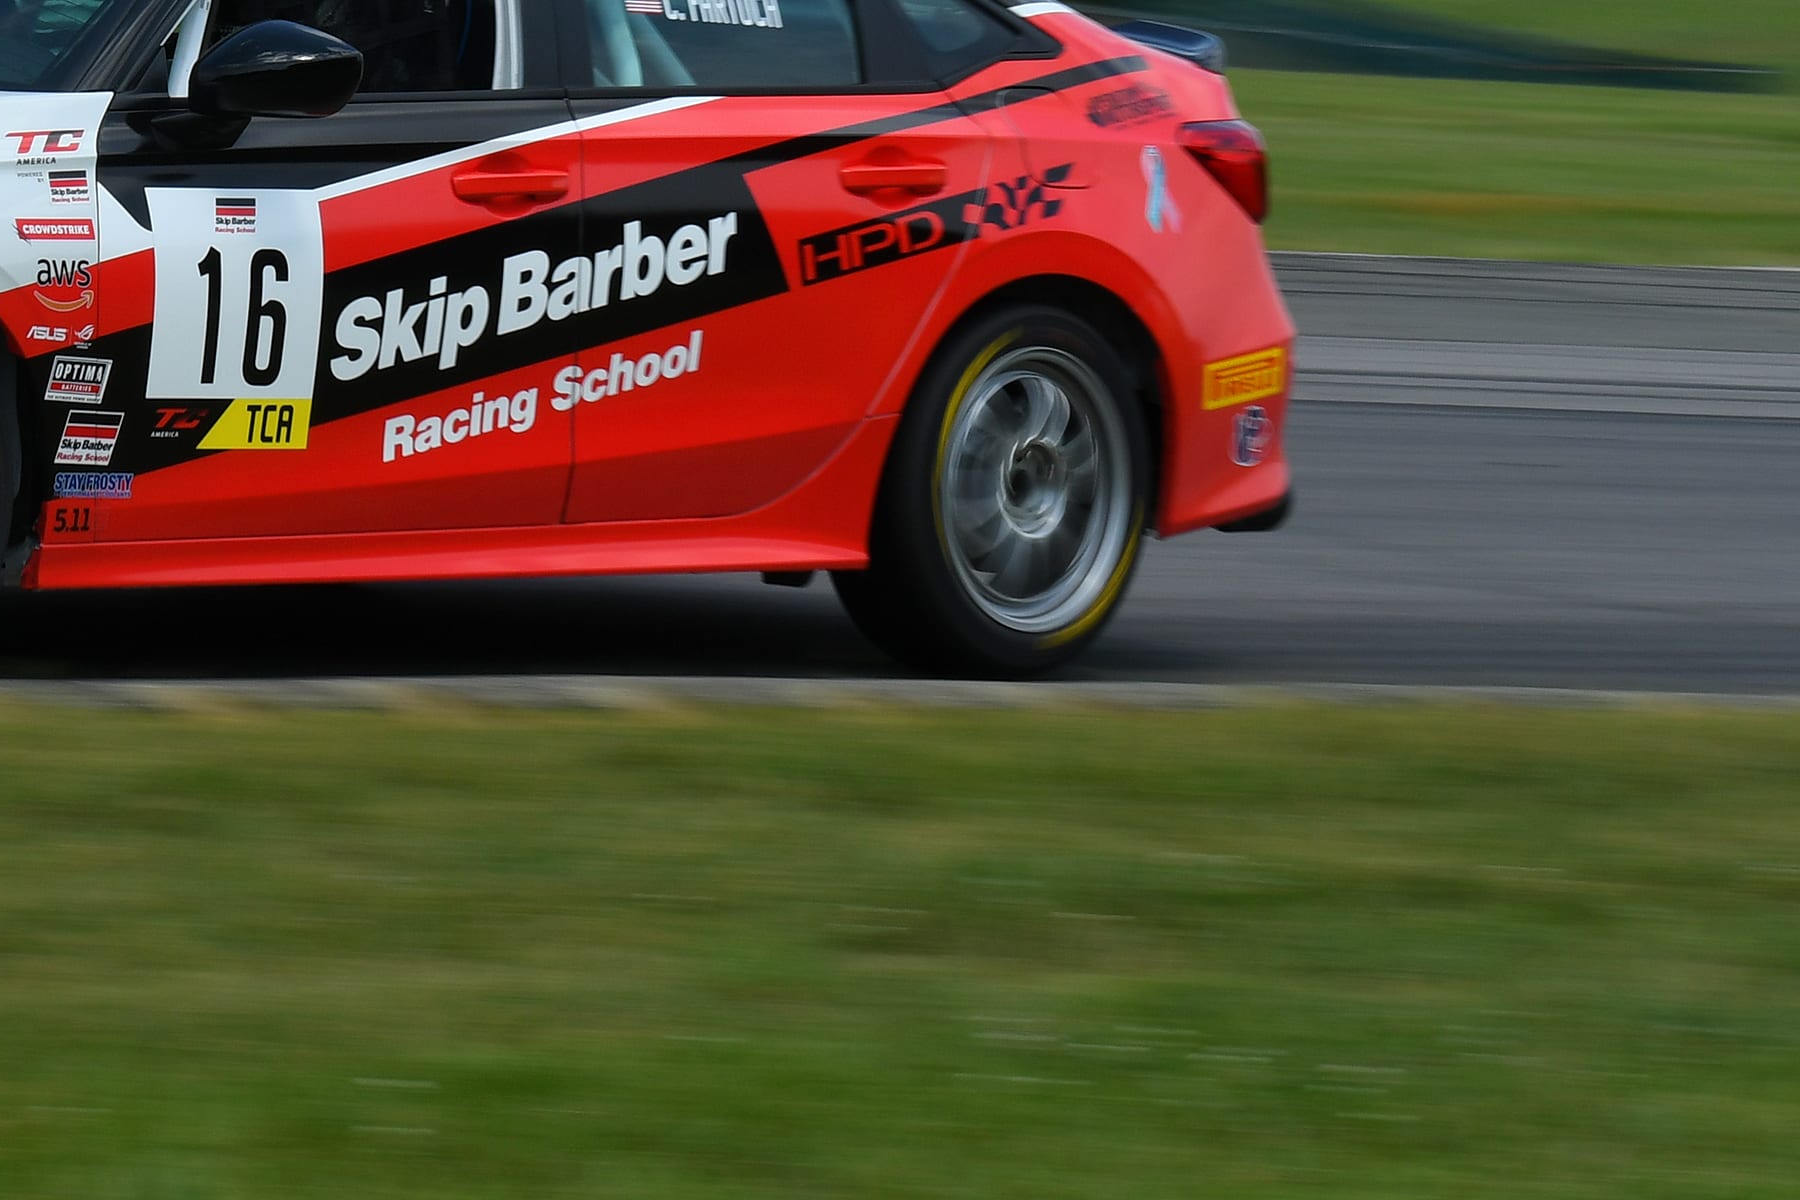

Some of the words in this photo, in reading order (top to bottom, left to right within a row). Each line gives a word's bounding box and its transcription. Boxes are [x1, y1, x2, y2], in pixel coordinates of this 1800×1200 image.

[5, 129, 85, 154] TC
[16, 157, 57, 166] AMERICA
[22, 224, 91, 235] CROWDSTRIKE
[215, 217, 231, 226] Skip
[232, 217, 256, 225] Barber
[802, 210, 946, 281] HPD
[36, 258, 91, 287] aws
[330, 275, 490, 382] Skip
[496, 211, 738, 336] Barber
[197, 245, 289, 386] 16
[26, 325, 68, 341] ASUS
[55, 362, 104, 382] OPTIMA
[61, 384, 92, 392] BATTERIES
[382, 386, 538, 462] Racing
[550, 330, 703, 411] School
[246, 404, 294, 444] TCA
[61, 438, 82, 451] Skip
[82, 439, 113, 451] Barber
[57, 452, 83, 462] Racing
[53, 508, 90, 532] 5.11
